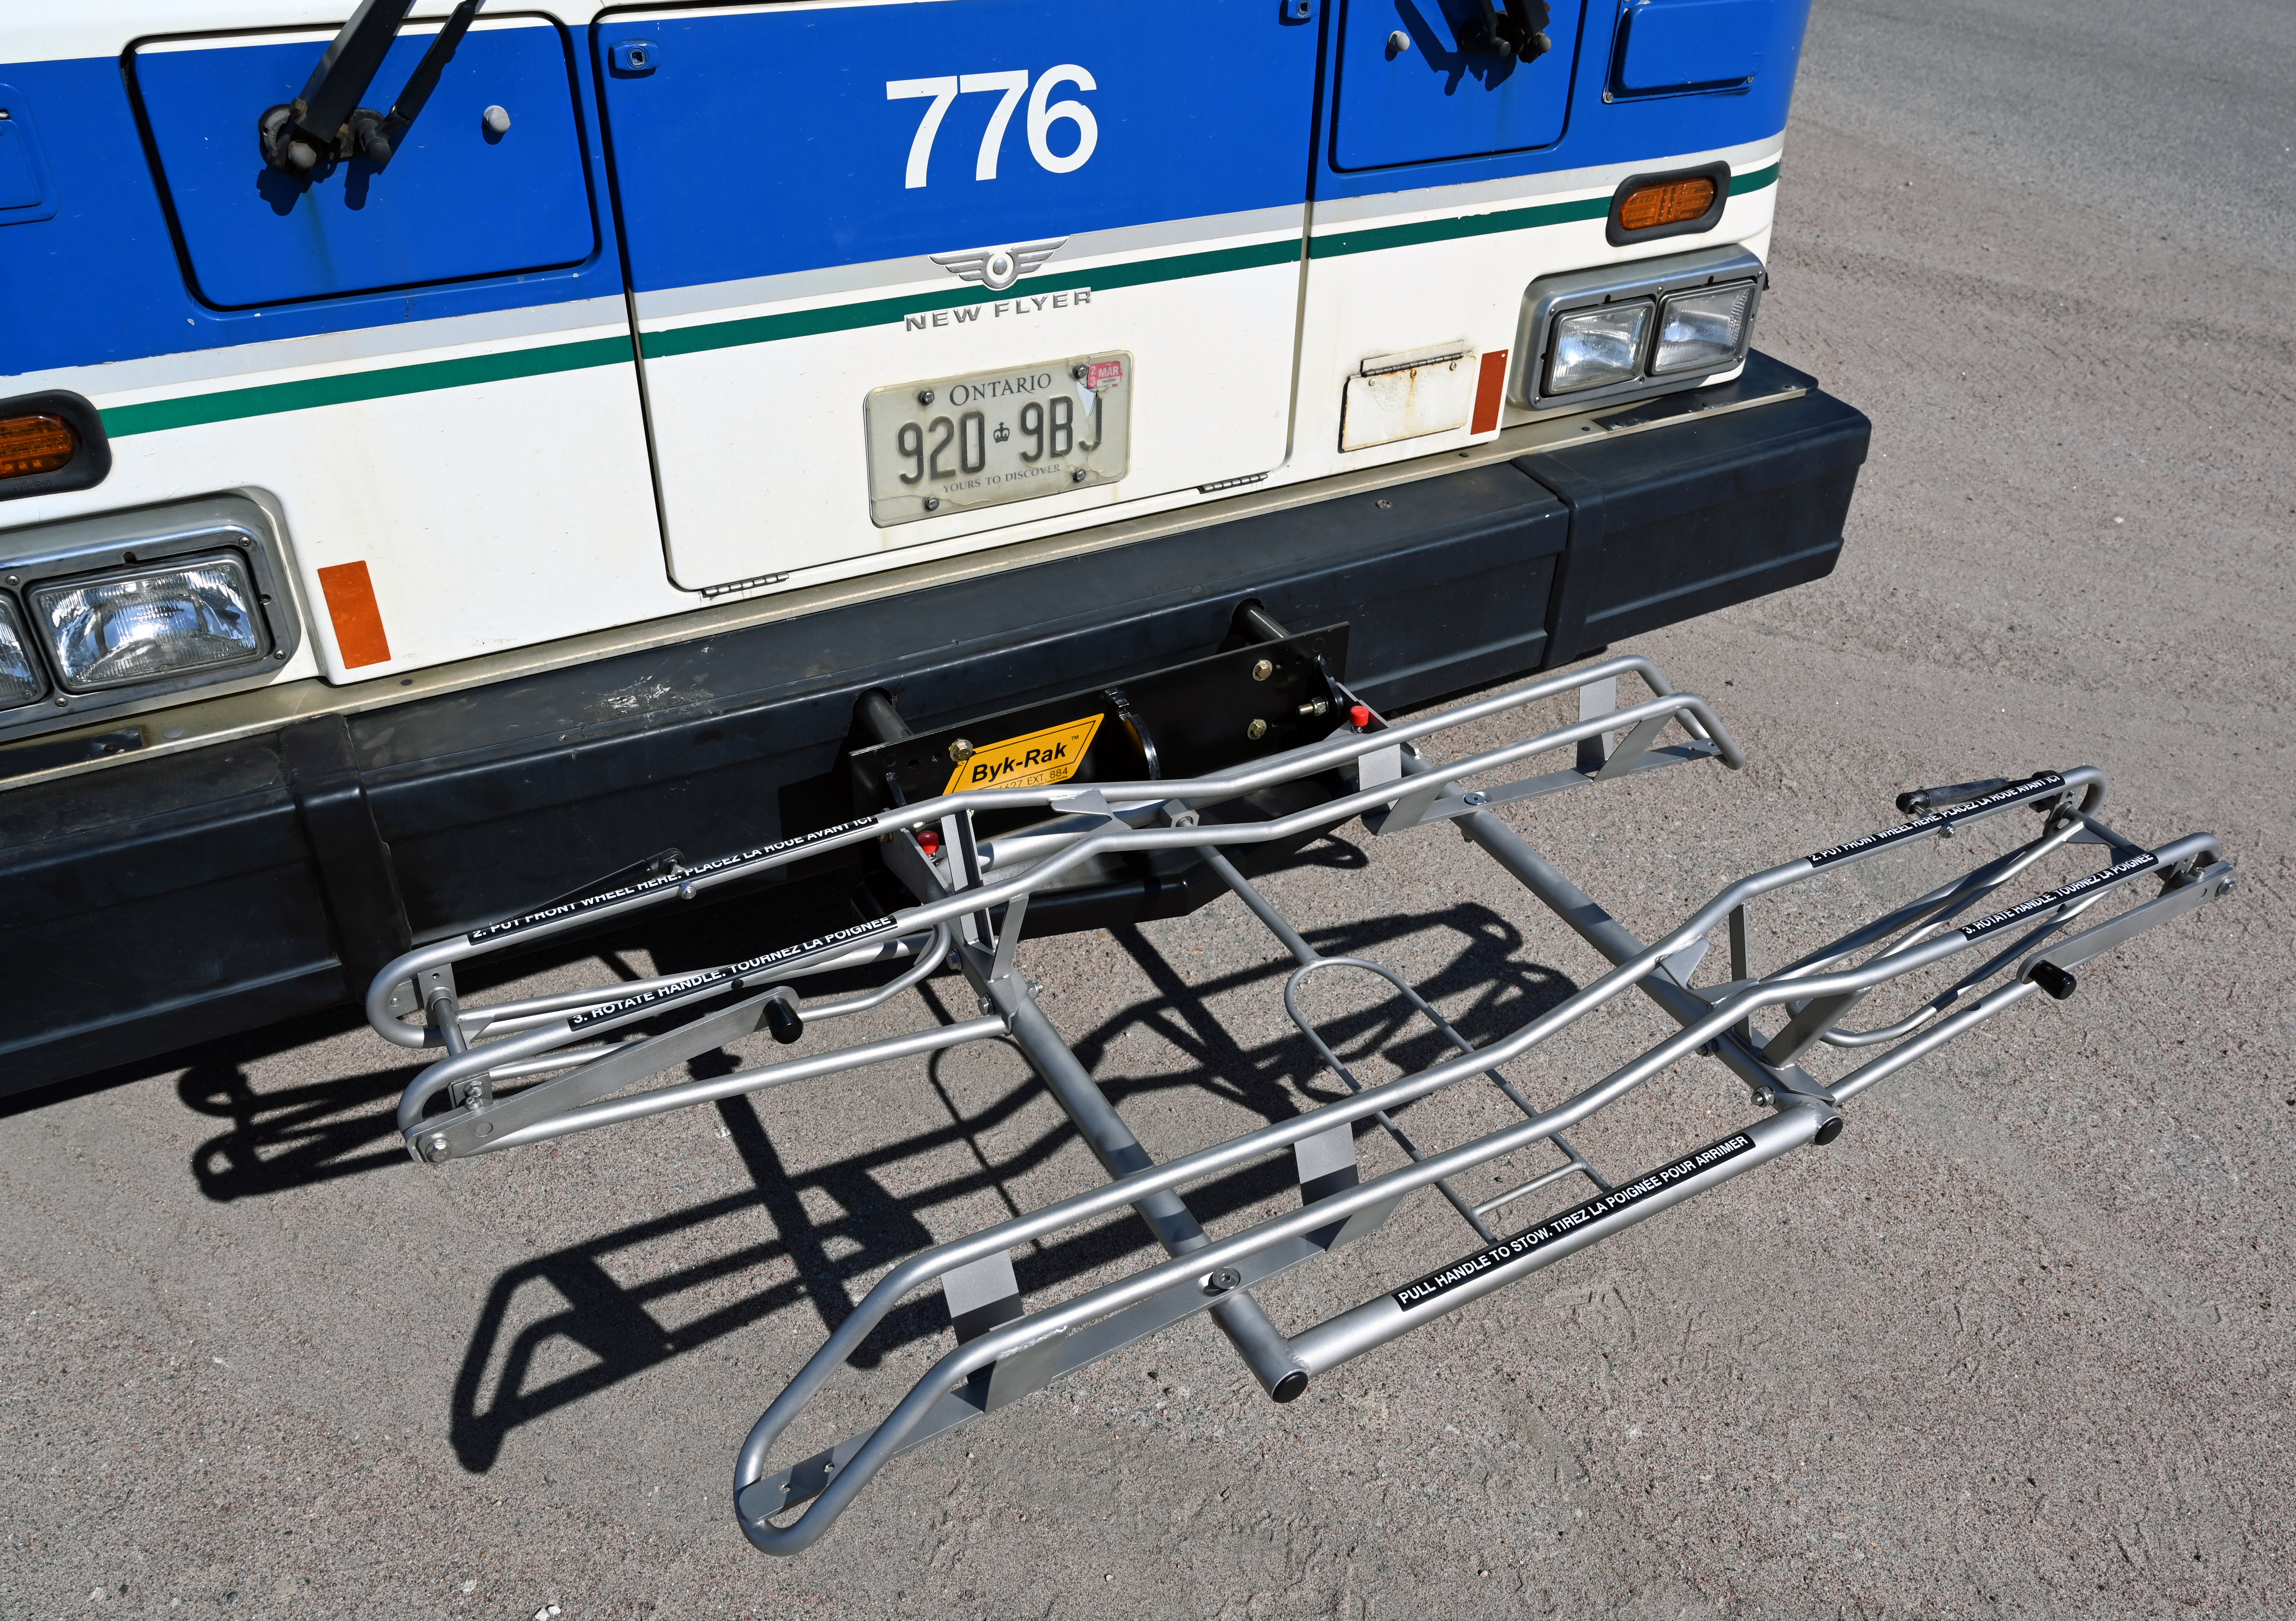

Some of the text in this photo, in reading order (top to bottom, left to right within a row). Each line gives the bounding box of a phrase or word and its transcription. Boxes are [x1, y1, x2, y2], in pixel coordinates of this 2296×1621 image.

[886, 64, 1098, 189] 776
[906, 289, 1091, 332] NEW FLYER
[1098, 366, 1119, 377] MAR
[897, 391, 1102, 484] 920 9BJ
[943, 464, 1060, 493] YOURS TO DISCOVER
[971, 742, 1067, 784] Byk-Rak
[1027, 773, 1046, 785] EXT.
[1050, 767, 1068, 779] 884
[1819, 846, 1842, 858] PUT
[1841, 835, 1877, 850] FRONT
[1875, 825, 1913, 839] WHEEL
[1910, 814, 1942, 827] HERE.
[1940, 802, 1979, 818] PLACEZ
[1977, 798, 1992, 806] LA
[1989, 788, 2018, 802] ROUE
[2015, 779, 2046, 793] AVANT
[2044, 775, 2061, 784] ICI
[473, 929, 486, 938] 2.
[490, 920, 520, 933] PUT
[525, 902, 576, 923] FRONT
[580, 887, 635, 906] WHEEL
[637, 873, 682, 891] HERE.
[685, 855, 741, 876] PLACEZ
[743, 849, 762, 860] LA
[765, 836, 804, 854] ROUE
[807, 823, 850, 840] AVANT
[1962, 926, 1976, 934] 3.
[1973, 908, 2015, 930] ROTATE
[2012, 893, 2057, 914] HANDLE.
[2051, 875, 2102, 897] TOURNEZ
[2096, 870, 2114, 880] LA
[573, 1014, 588, 1025] 3.
[591, 991, 655, 1018] ROTATE
[657, 970, 726, 997] HANDLE.
[728, 945, 802, 974] TOURNEZ
[802, 938, 823, 950] LA
[1398, 1136, 1749, 1304] PULL HANDLE TO STOW. TIREZ LA POIGNÉE POUR ARRIMER
